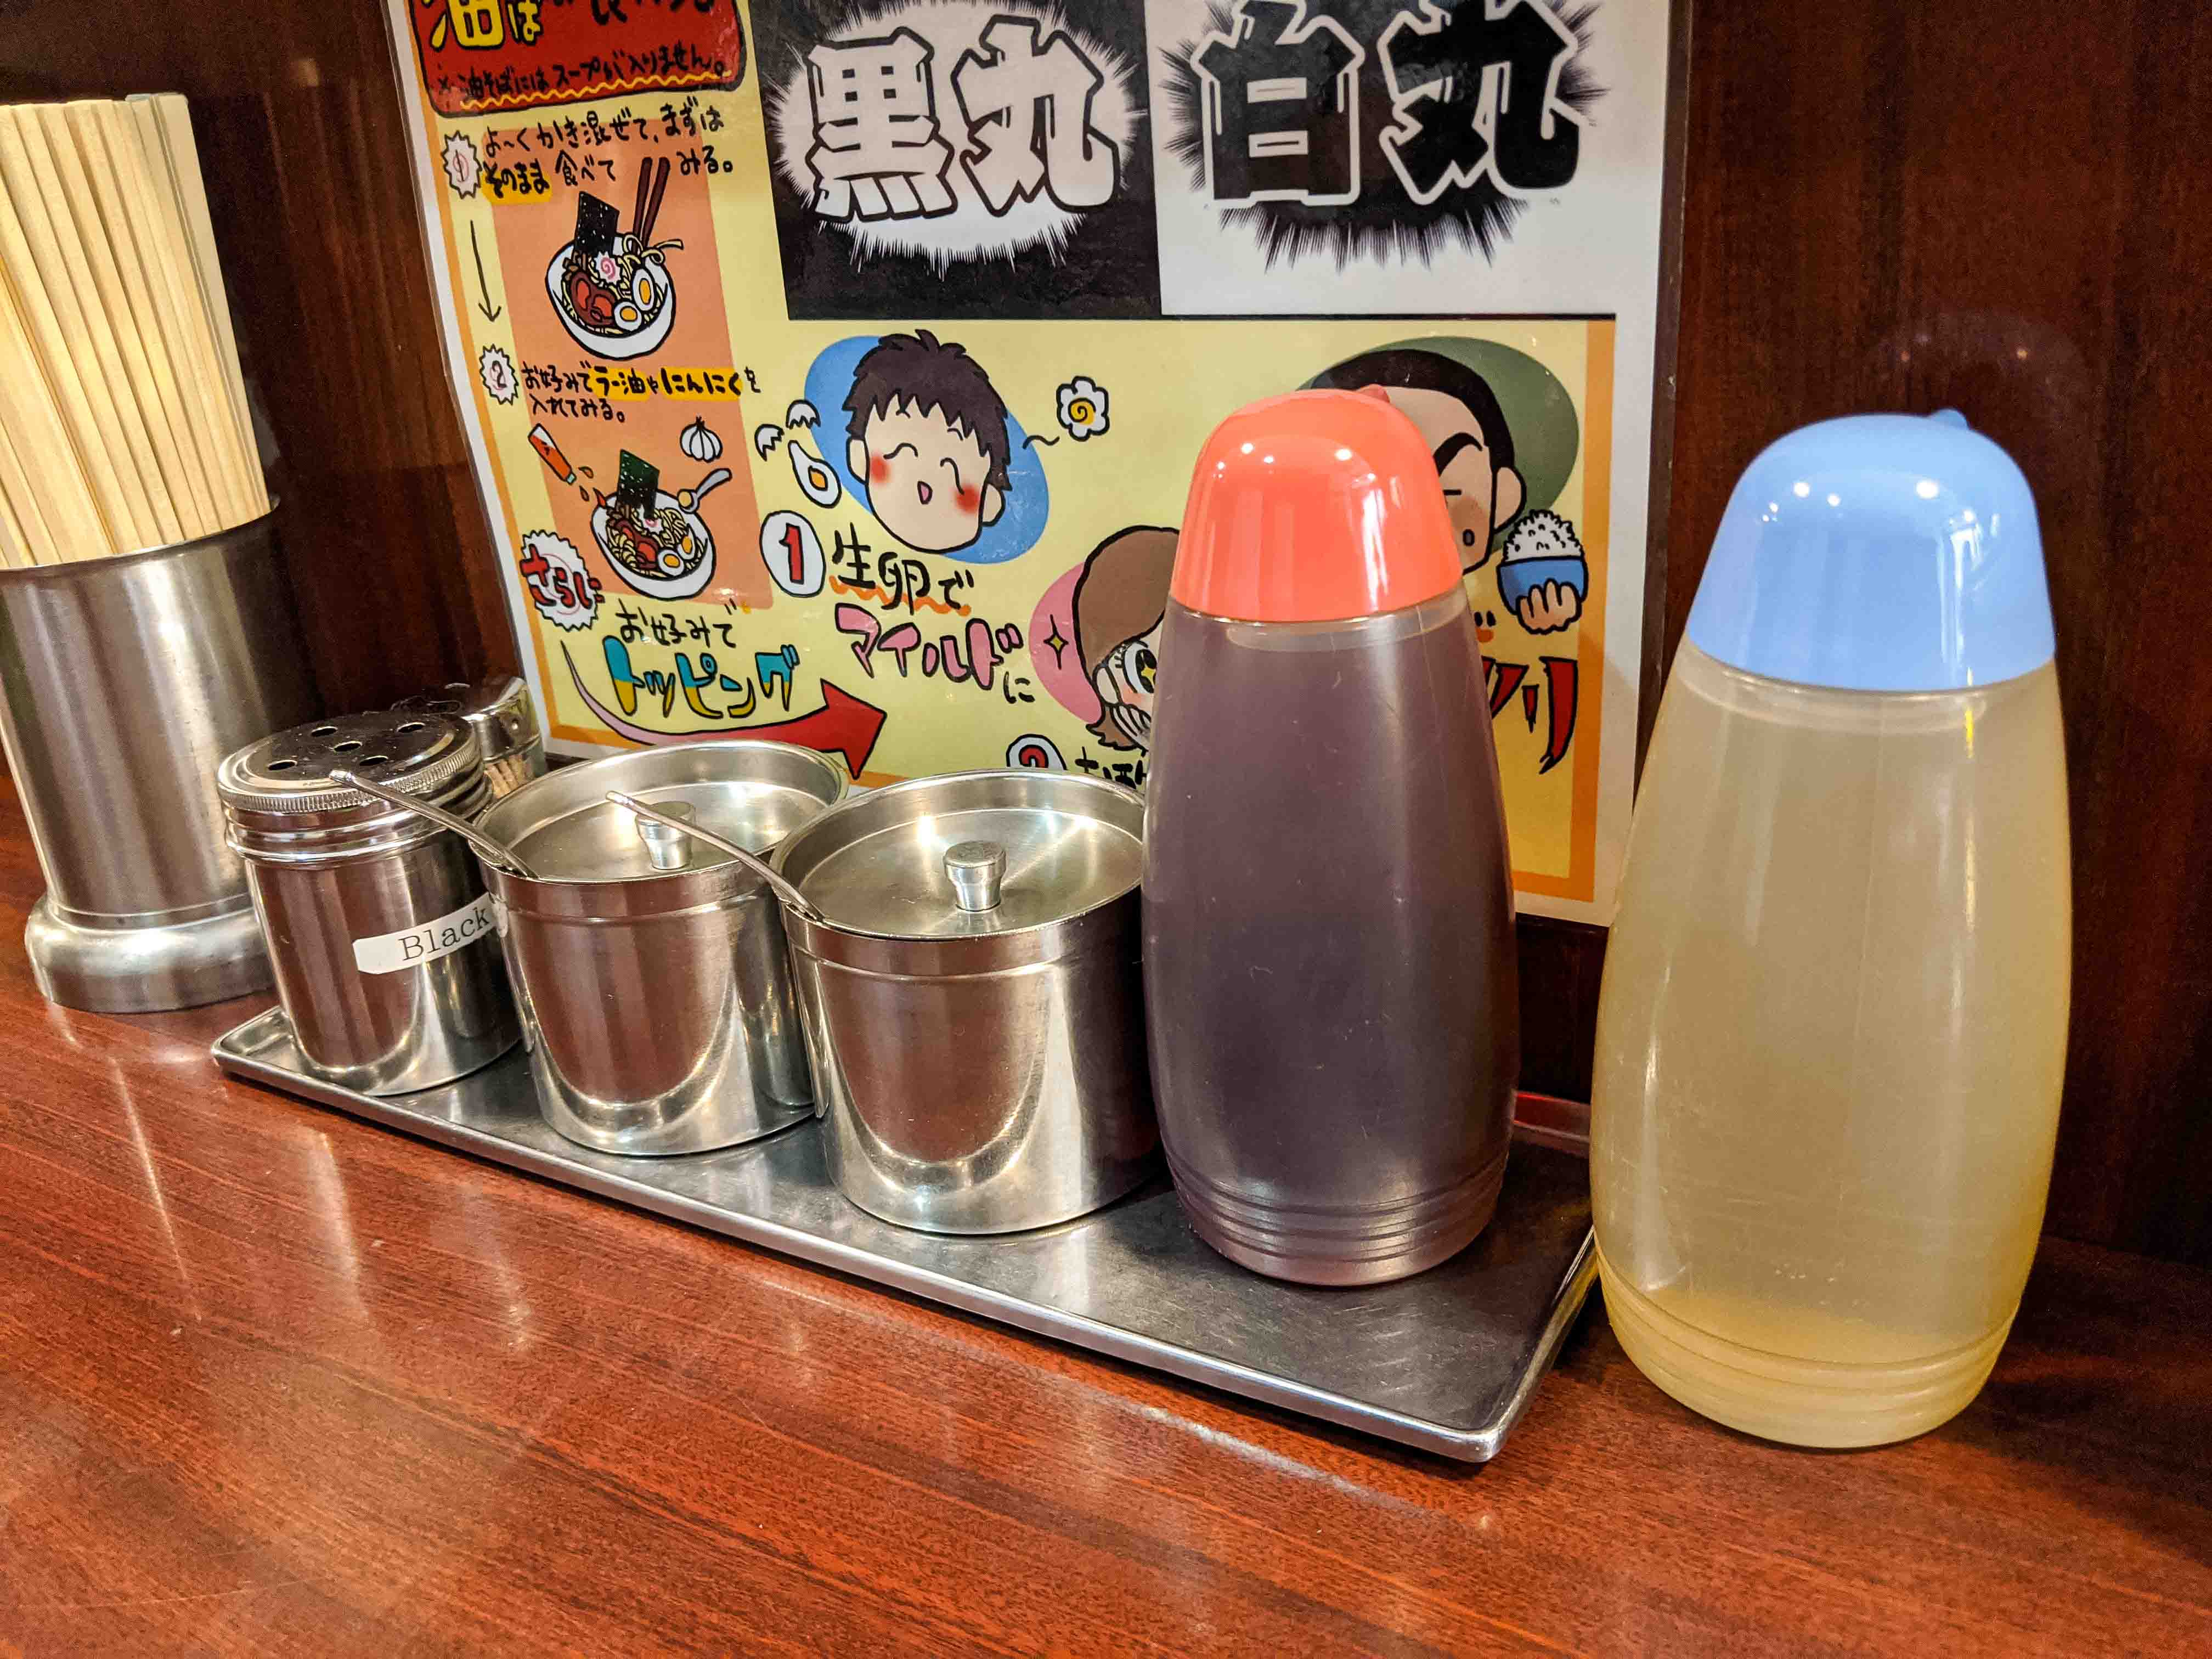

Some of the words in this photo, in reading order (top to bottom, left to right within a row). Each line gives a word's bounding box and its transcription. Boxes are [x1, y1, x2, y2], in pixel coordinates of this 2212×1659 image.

[805, 14, 1120, 223] 黒丸
[1190, 0, 1583, 206] 白丸
[519, 543, 605, 609] さらに
[831, 523, 975, 614] 生卵で
[616, 599, 736, 648] お好みで
[602, 635, 800, 720] トッピング
[398, 906, 489, 961] Black
